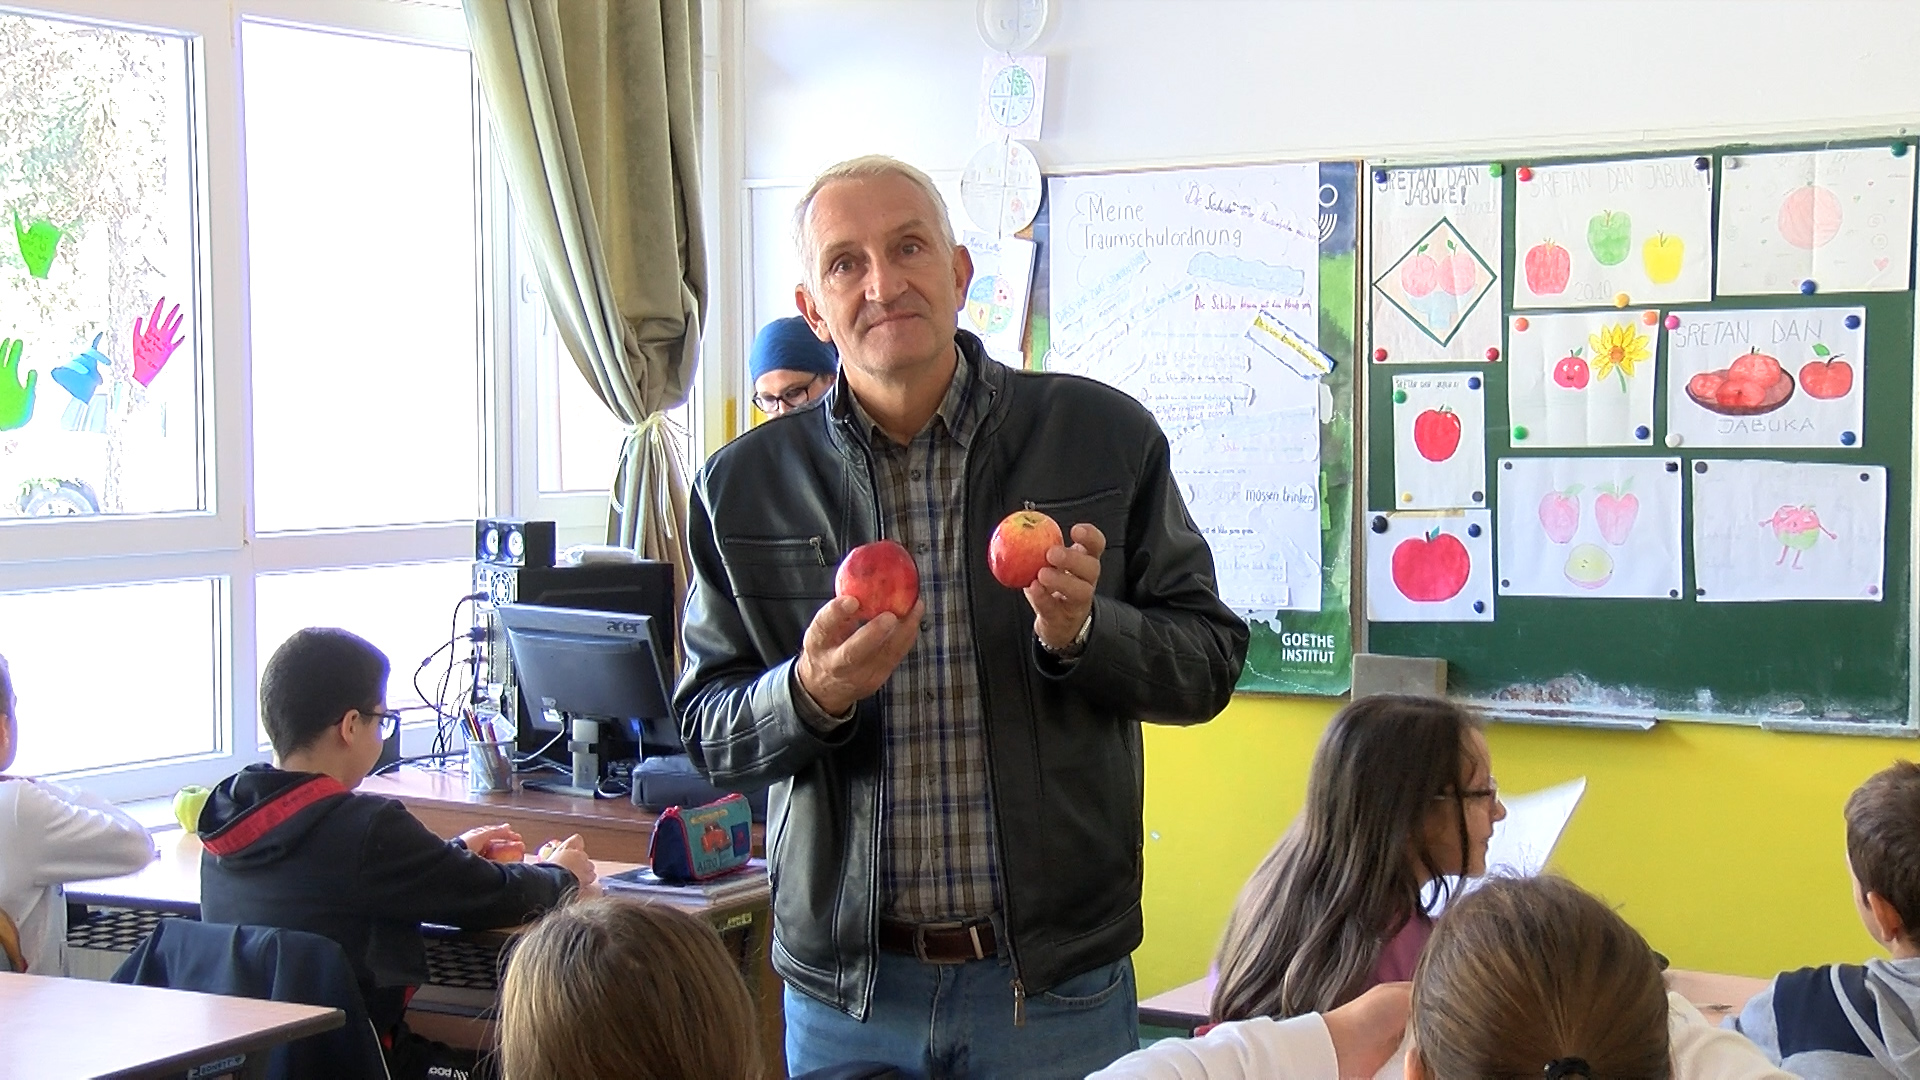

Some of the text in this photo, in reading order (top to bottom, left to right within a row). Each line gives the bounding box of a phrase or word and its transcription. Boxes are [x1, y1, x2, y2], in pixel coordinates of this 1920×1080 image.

[1446, 165, 1479, 189] DAN
[1530, 168, 1592, 198] SRETAN
[1607, 165, 1635, 194] DAN
[1404, 185, 1468, 206] JABUKE!
[1089, 196, 1145, 222] Meine
[1078, 224, 1243, 249] Traumschulordnung
[1675, 319, 1823, 349] SRETAN DAN
[1717, 417, 1815, 434] JABUKA
[607, 620, 641, 634] acer
[1281, 632, 1335, 649] GOETHE
[1281, 647, 1336, 664] INSTITUT
